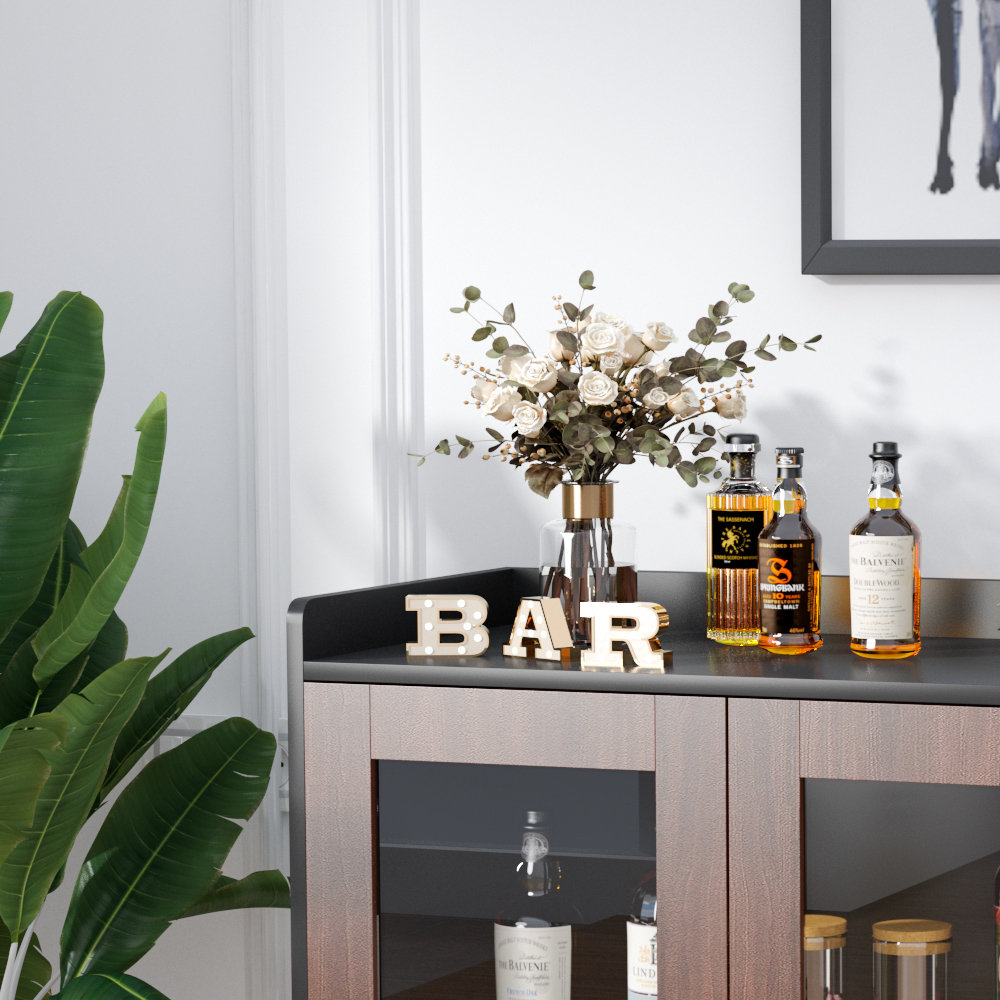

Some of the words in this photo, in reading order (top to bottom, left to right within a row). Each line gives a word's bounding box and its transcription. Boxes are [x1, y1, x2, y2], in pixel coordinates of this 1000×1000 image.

[772, 592, 785, 600] 10
[867, 594, 880, 604] 12
[508, 959, 549, 972] BALVENIE
[632, 966, 656, 978] LIND
